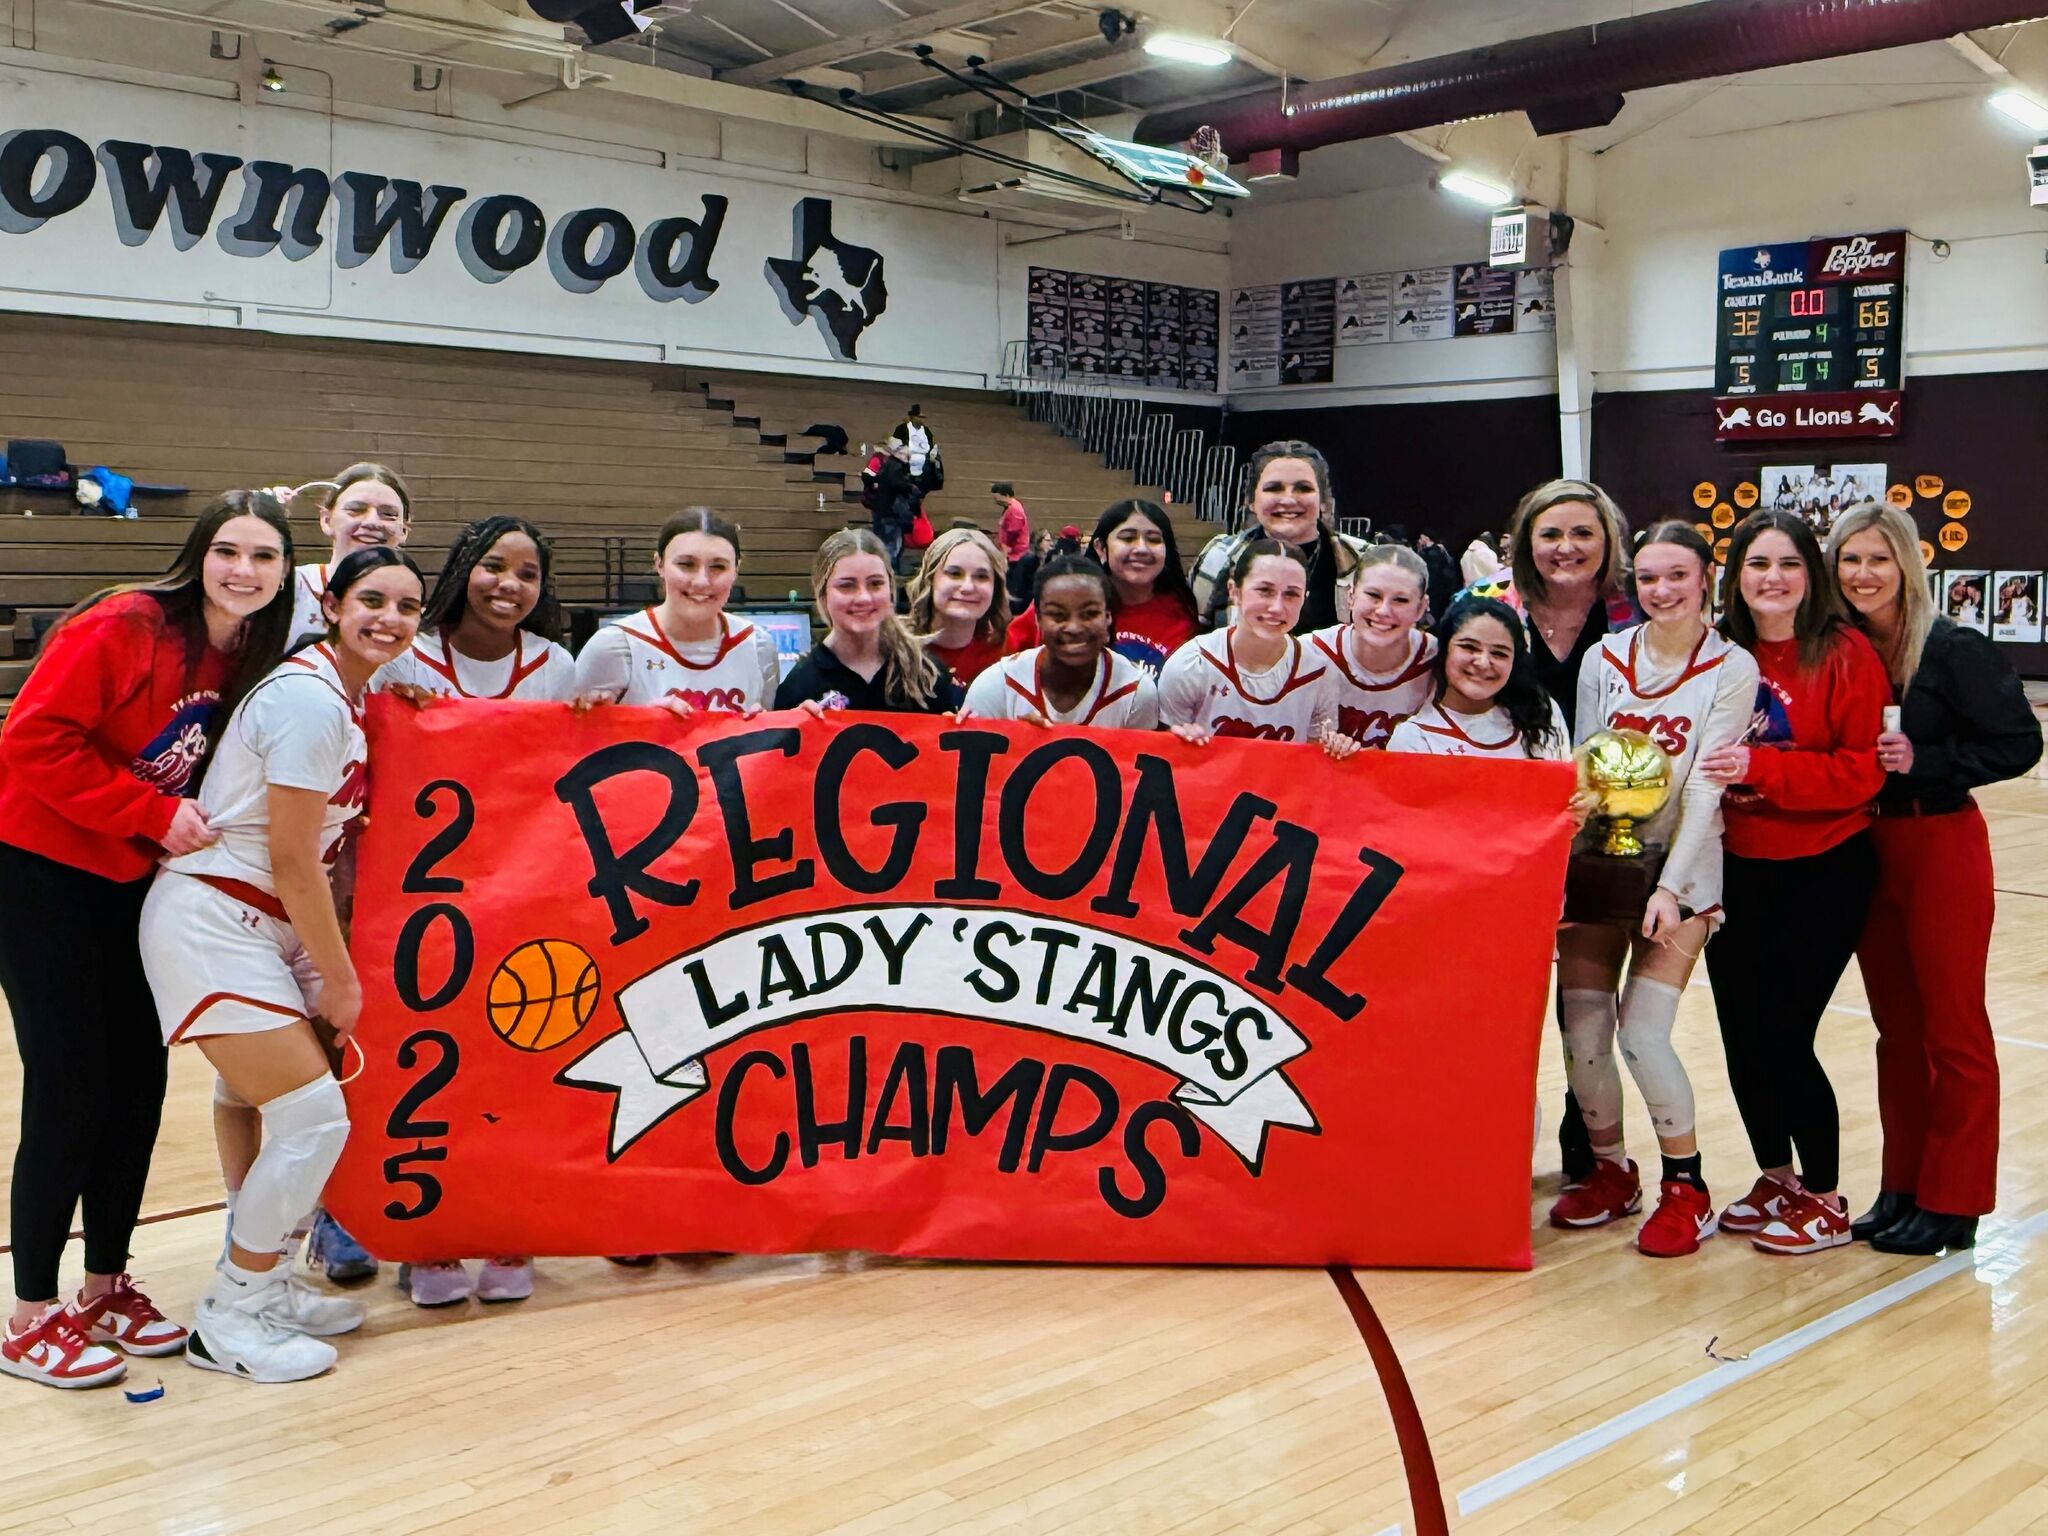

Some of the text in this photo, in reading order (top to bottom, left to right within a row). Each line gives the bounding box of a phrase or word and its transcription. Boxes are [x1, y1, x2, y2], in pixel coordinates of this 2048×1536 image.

[1849, 237, 1876, 256] Dr
[1822, 245, 1897, 276] Pepper
[1732, 311, 1761, 336] 32
[1859, 301, 1889, 328] 66
[1815, 323, 1828, 343] 4
[1816, 361, 1829, 381] 4
[1866, 357, 1879, 378] 5
[1756, 407, 1853, 427] Go Lions
[554, 723, 1404, 1022] REGIONAL
[683, 912, 933, 1029] LADY
[715, 1035, 1201, 1219] CHAMPS
